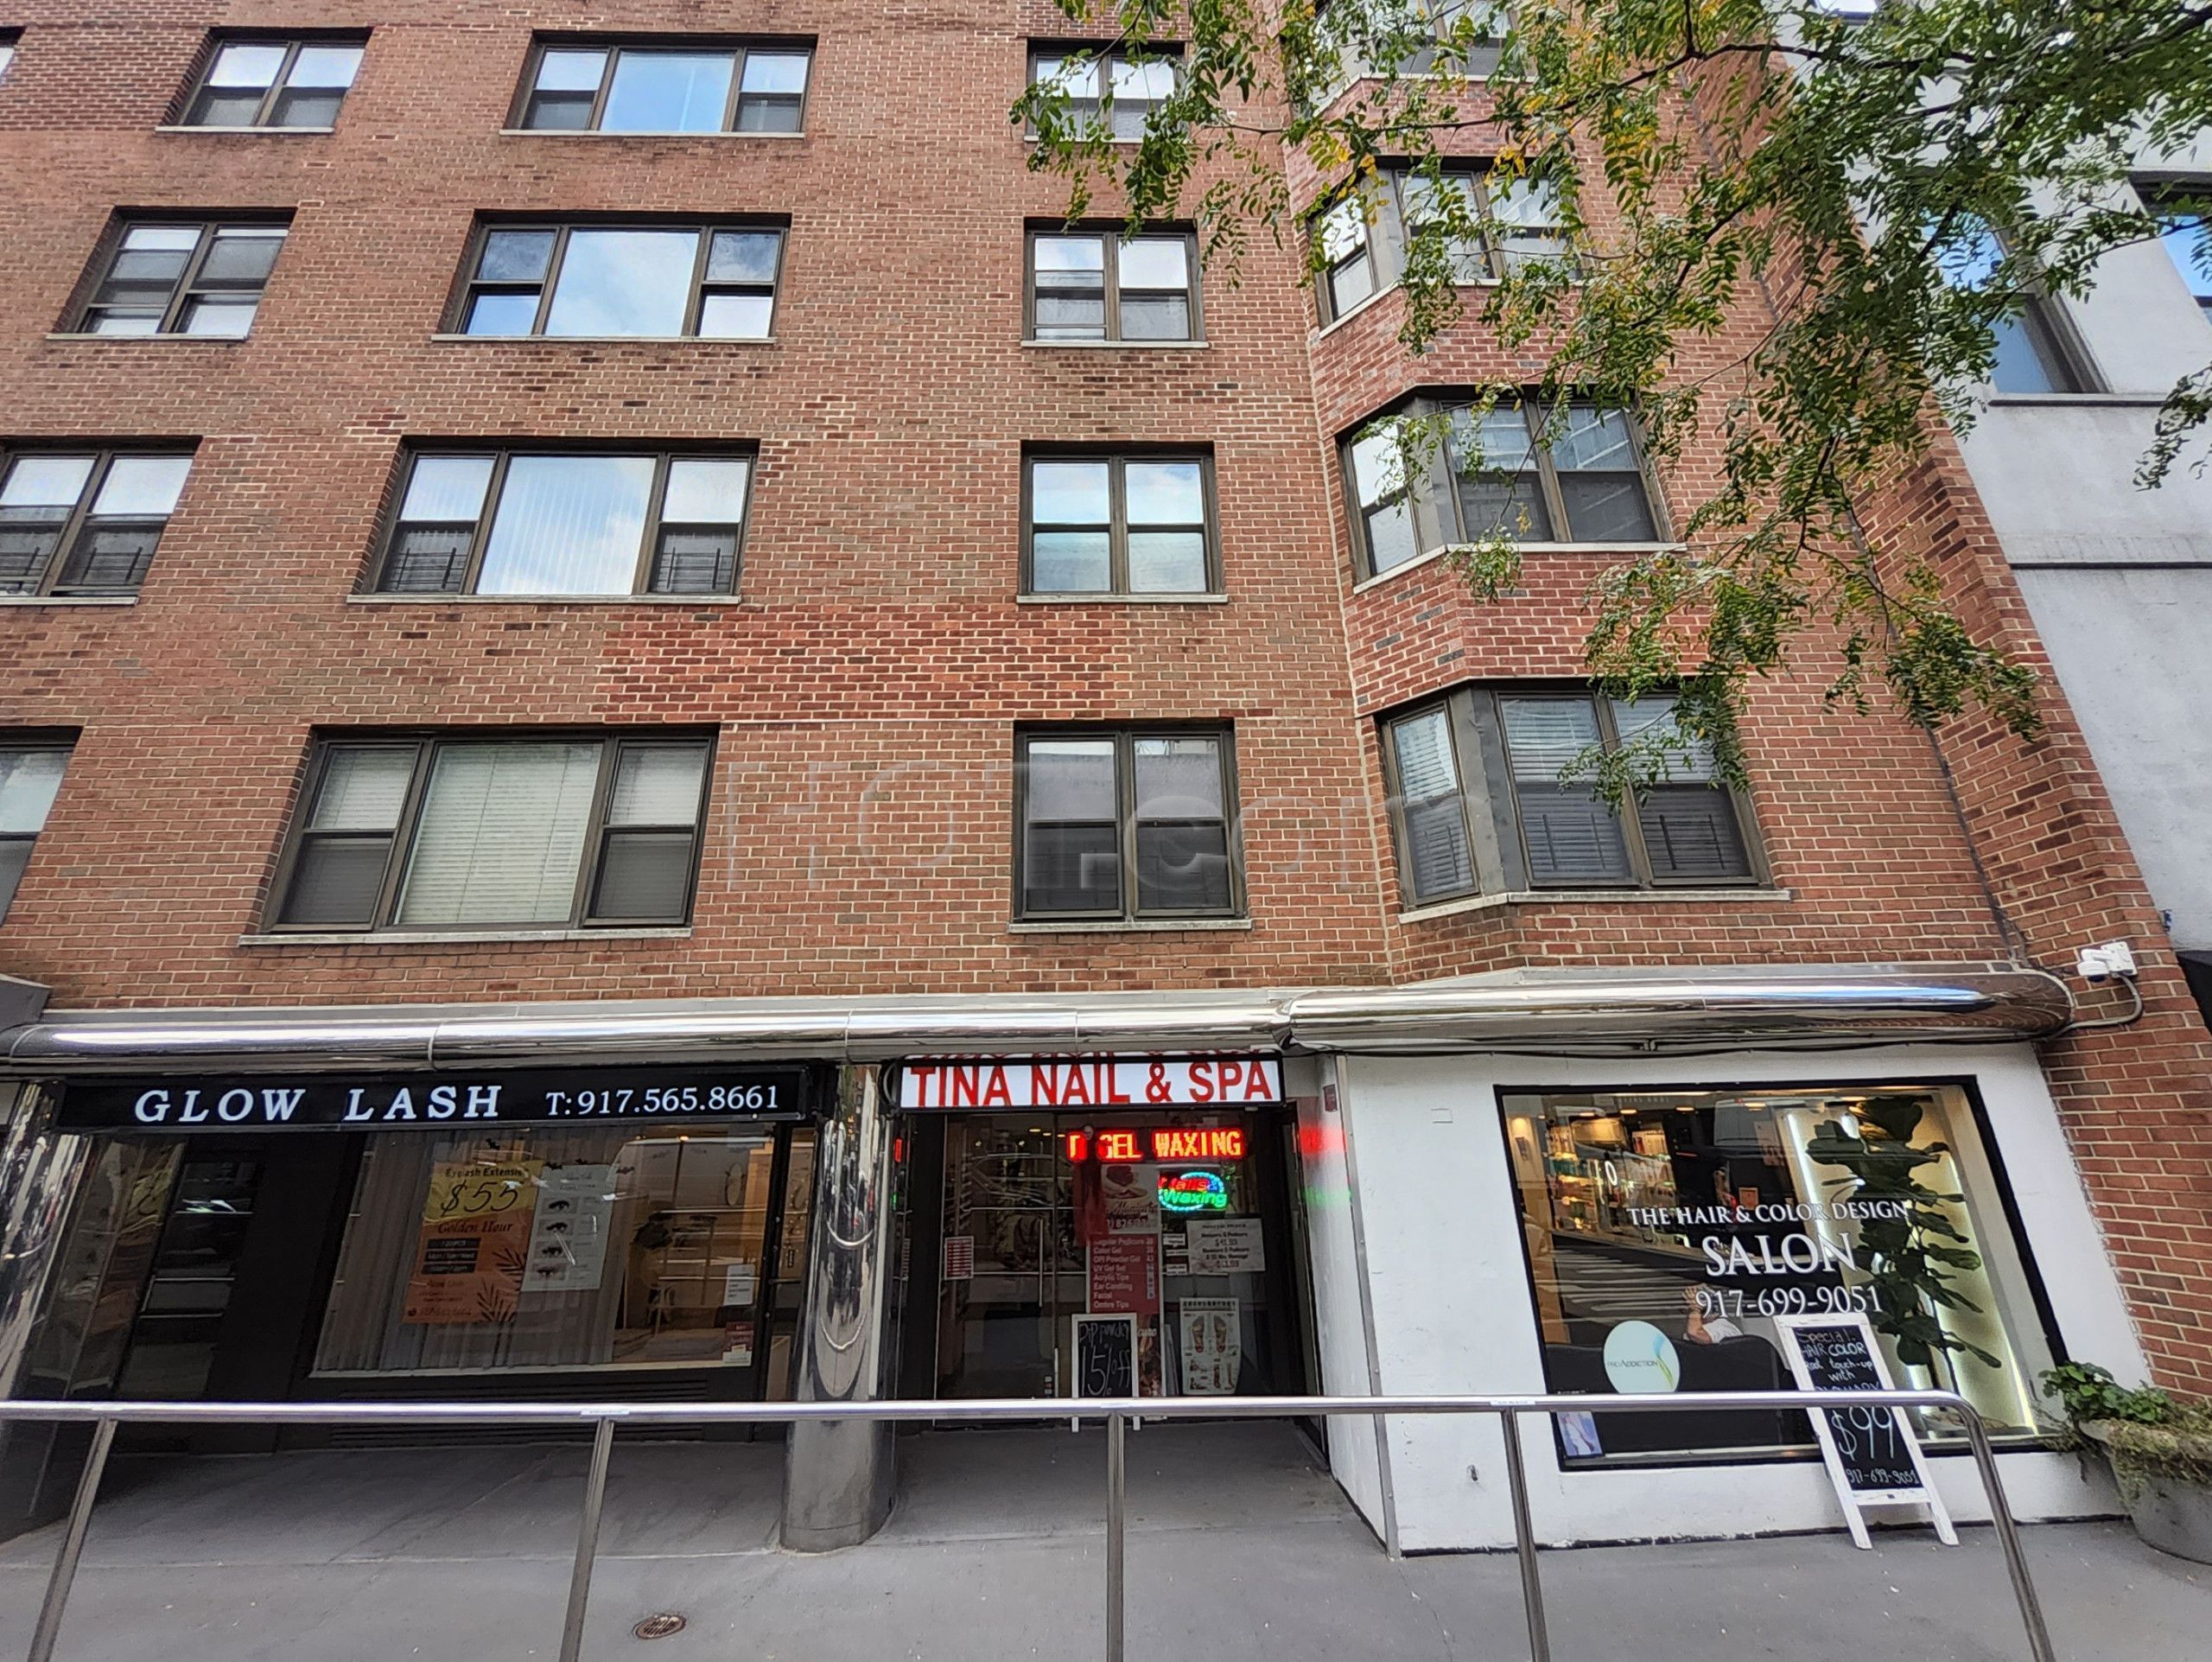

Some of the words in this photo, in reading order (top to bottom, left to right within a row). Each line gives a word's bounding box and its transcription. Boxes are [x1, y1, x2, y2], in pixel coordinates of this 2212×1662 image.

[910, 1066, 1012, 1108] TINA
[1031, 1064, 1130, 1106] NAIL
[1145, 1061, 1173, 1103] &
[1189, 1060, 1273, 1101] SPA
[135, 1089, 306, 1122] GLOW
[342, 1086, 501, 1122] LASH
[545, 1086, 779, 1116] T:917.565.8661
[1154, 1130, 1243, 1158] WAXING
[1163, 1189, 1227, 1207] Waxing
[481, 1220, 513, 1233] Hour
[1627, 1207, 1670, 1226] THE
[1675, 1206, 1732, 1225] HAIR
[1735, 1206, 1753, 1223] &
[1755, 1202, 1831, 1223] COLOR
[1831, 1200, 1910, 1220] DESIGN
[1701, 1232, 1859, 1277] SALON
[1695, 1284, 1885, 1318] 917-699-9051
[1828, 1341, 1866, 1357] COLOR
[1827, 1368, 1856, 1382] with
[1831, 1406, 1895, 1461] $99
